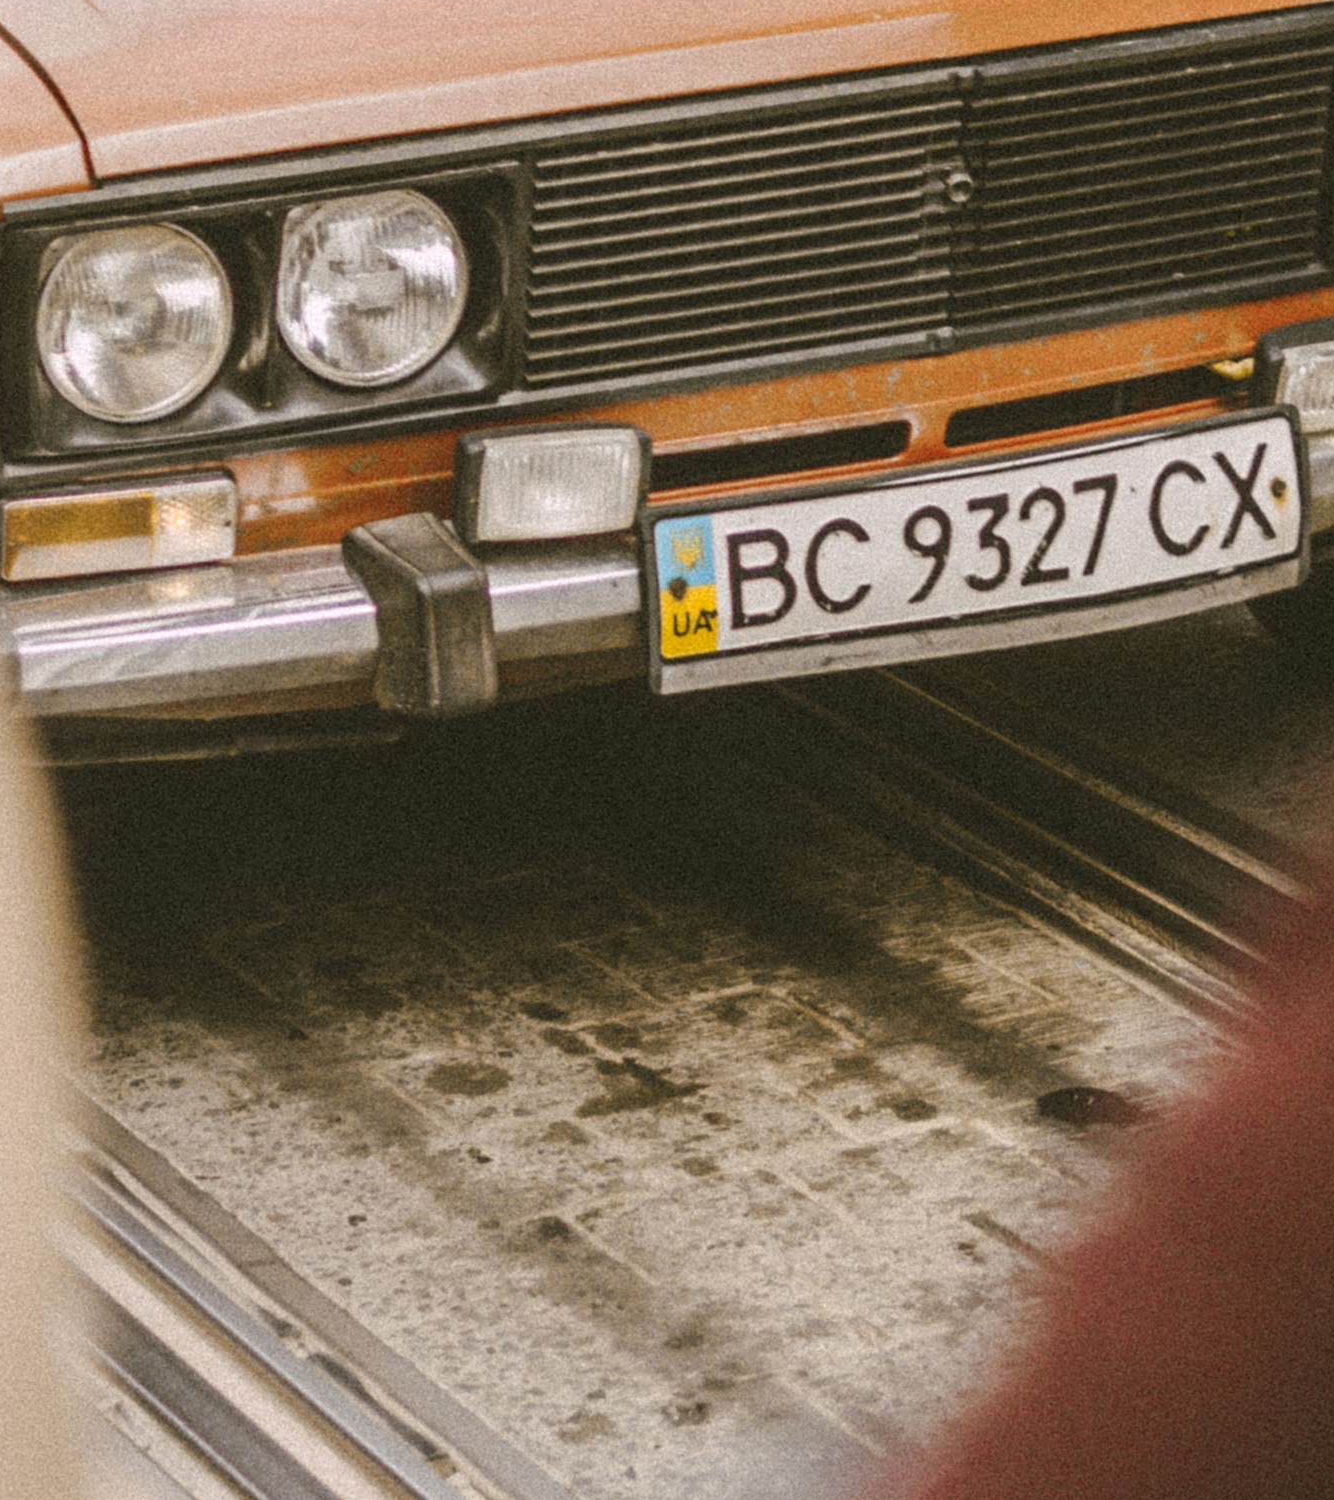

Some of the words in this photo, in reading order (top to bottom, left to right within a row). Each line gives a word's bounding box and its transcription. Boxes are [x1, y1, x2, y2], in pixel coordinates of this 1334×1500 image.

[725, 517, 872, 630] BC
[902, 472, 1121, 604] 9327
[1147, 442, 1279, 557] CX
[672, 610, 714, 638] UA
